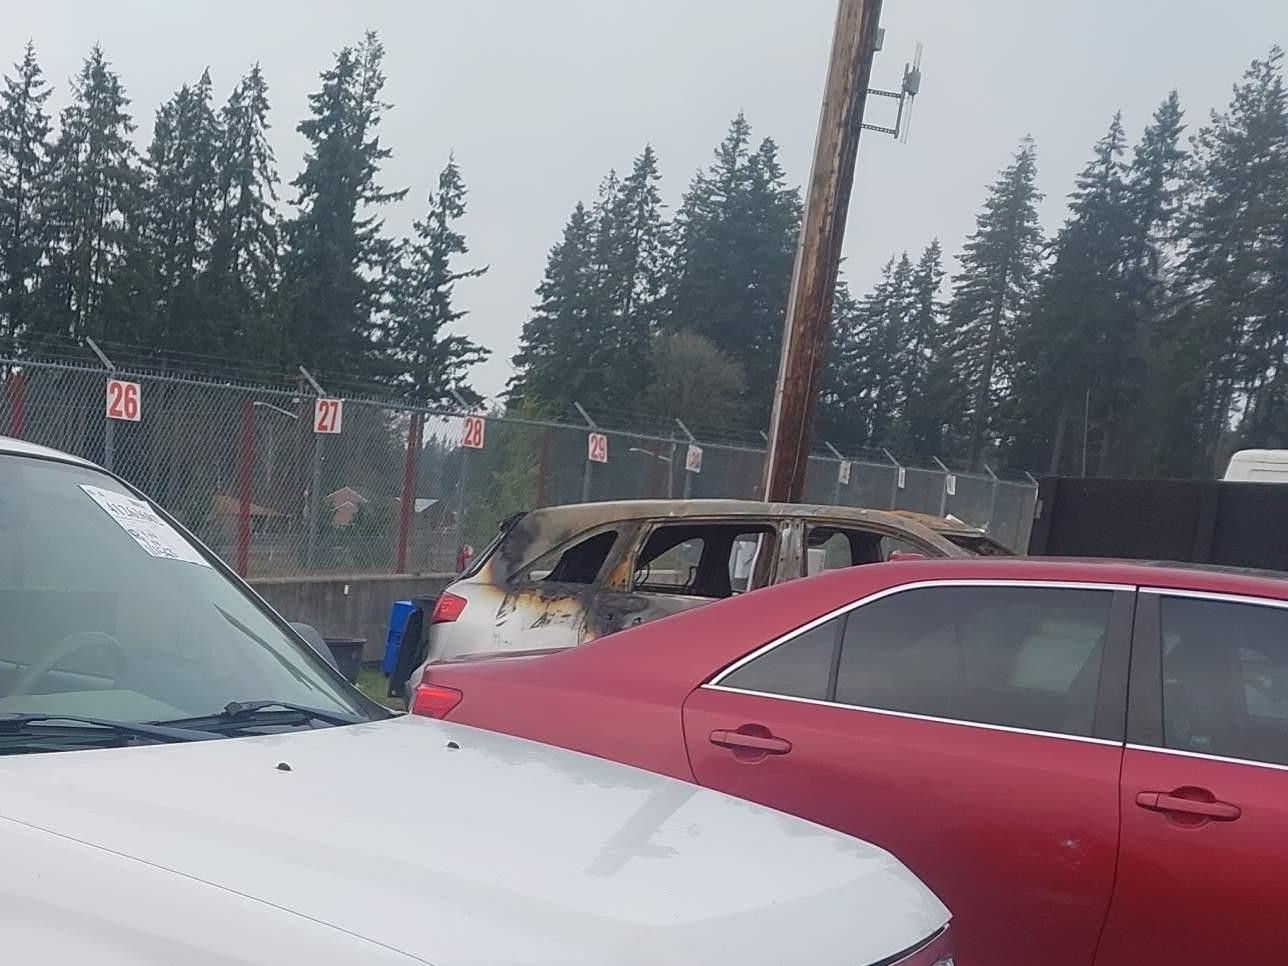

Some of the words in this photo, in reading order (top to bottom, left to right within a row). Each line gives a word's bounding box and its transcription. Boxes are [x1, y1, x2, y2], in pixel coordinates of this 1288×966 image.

[109, 381, 138, 419] 26
[317, 400, 339, 432] 27
[463, 417, 482, 447] 28
